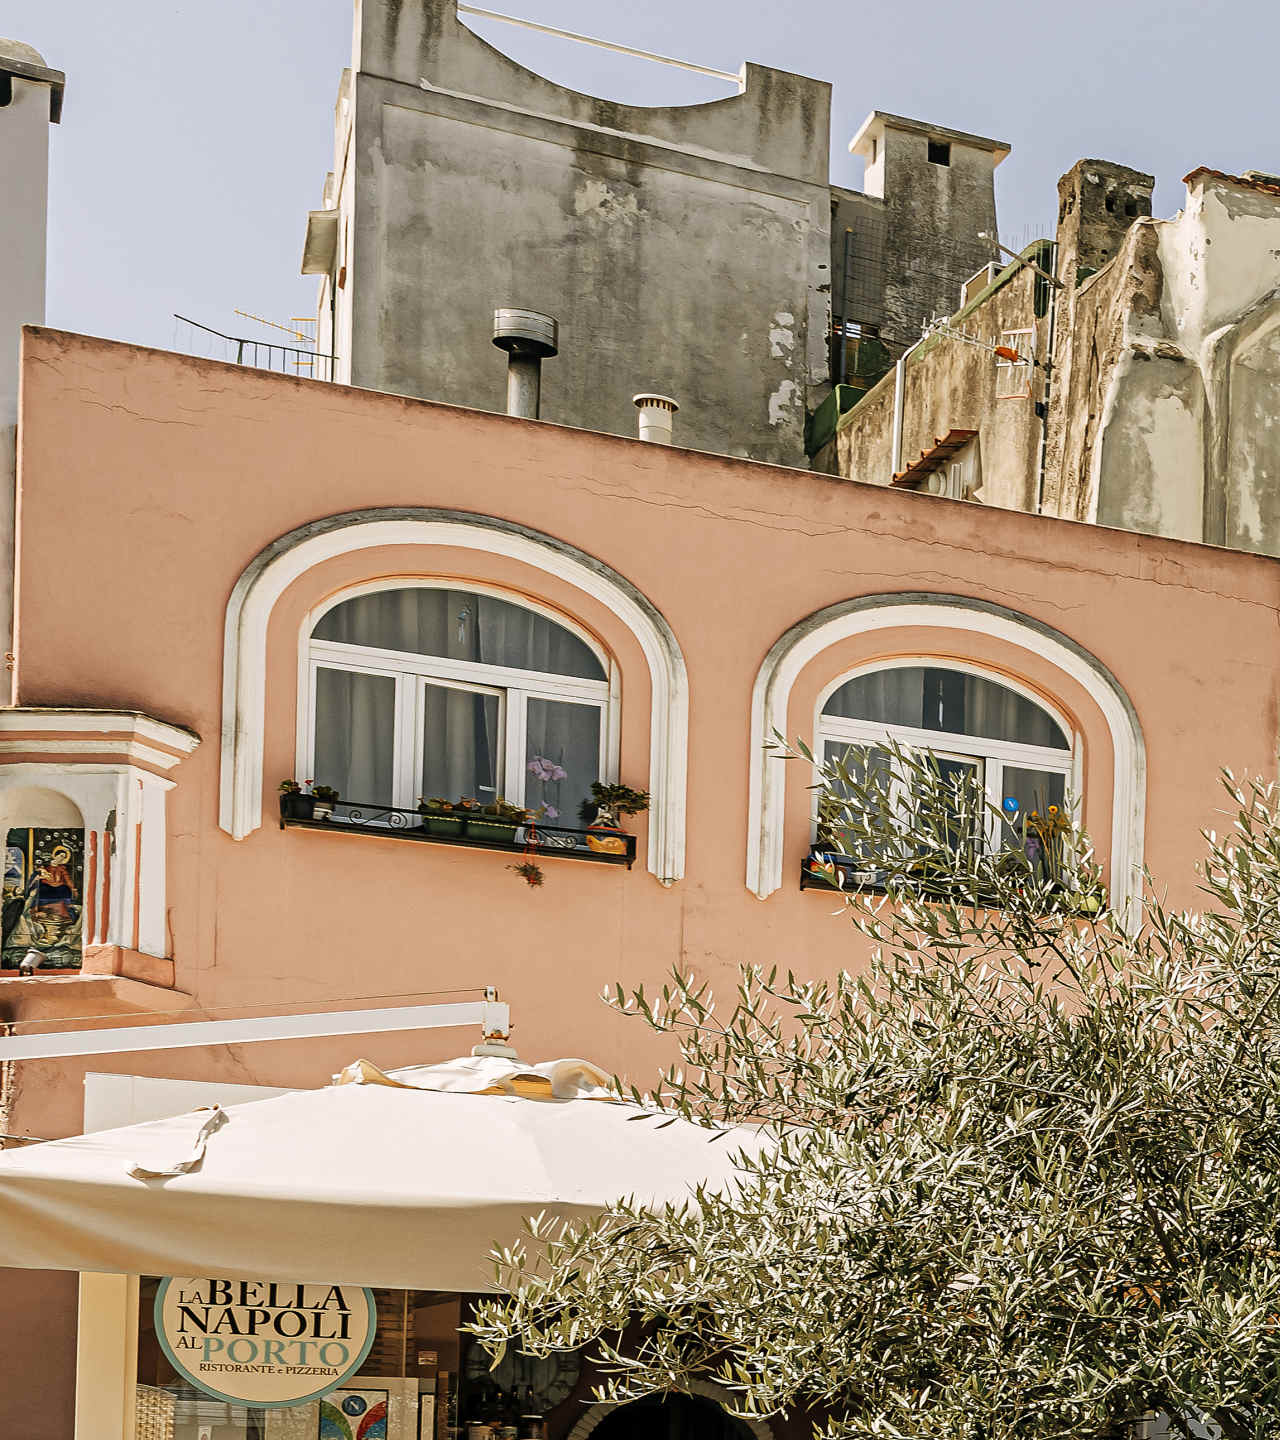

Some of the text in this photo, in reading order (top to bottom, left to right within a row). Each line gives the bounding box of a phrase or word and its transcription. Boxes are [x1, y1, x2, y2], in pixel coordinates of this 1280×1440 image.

[178, 1278, 352, 1312] LA BELLA
[176, 1305, 353, 1340] NAPOLI
[175, 1335, 350, 1367] AL PORTO
[199, 1363, 275, 1374] RISTORANTE
[285, 1366, 340, 1377] PIZZERIA
